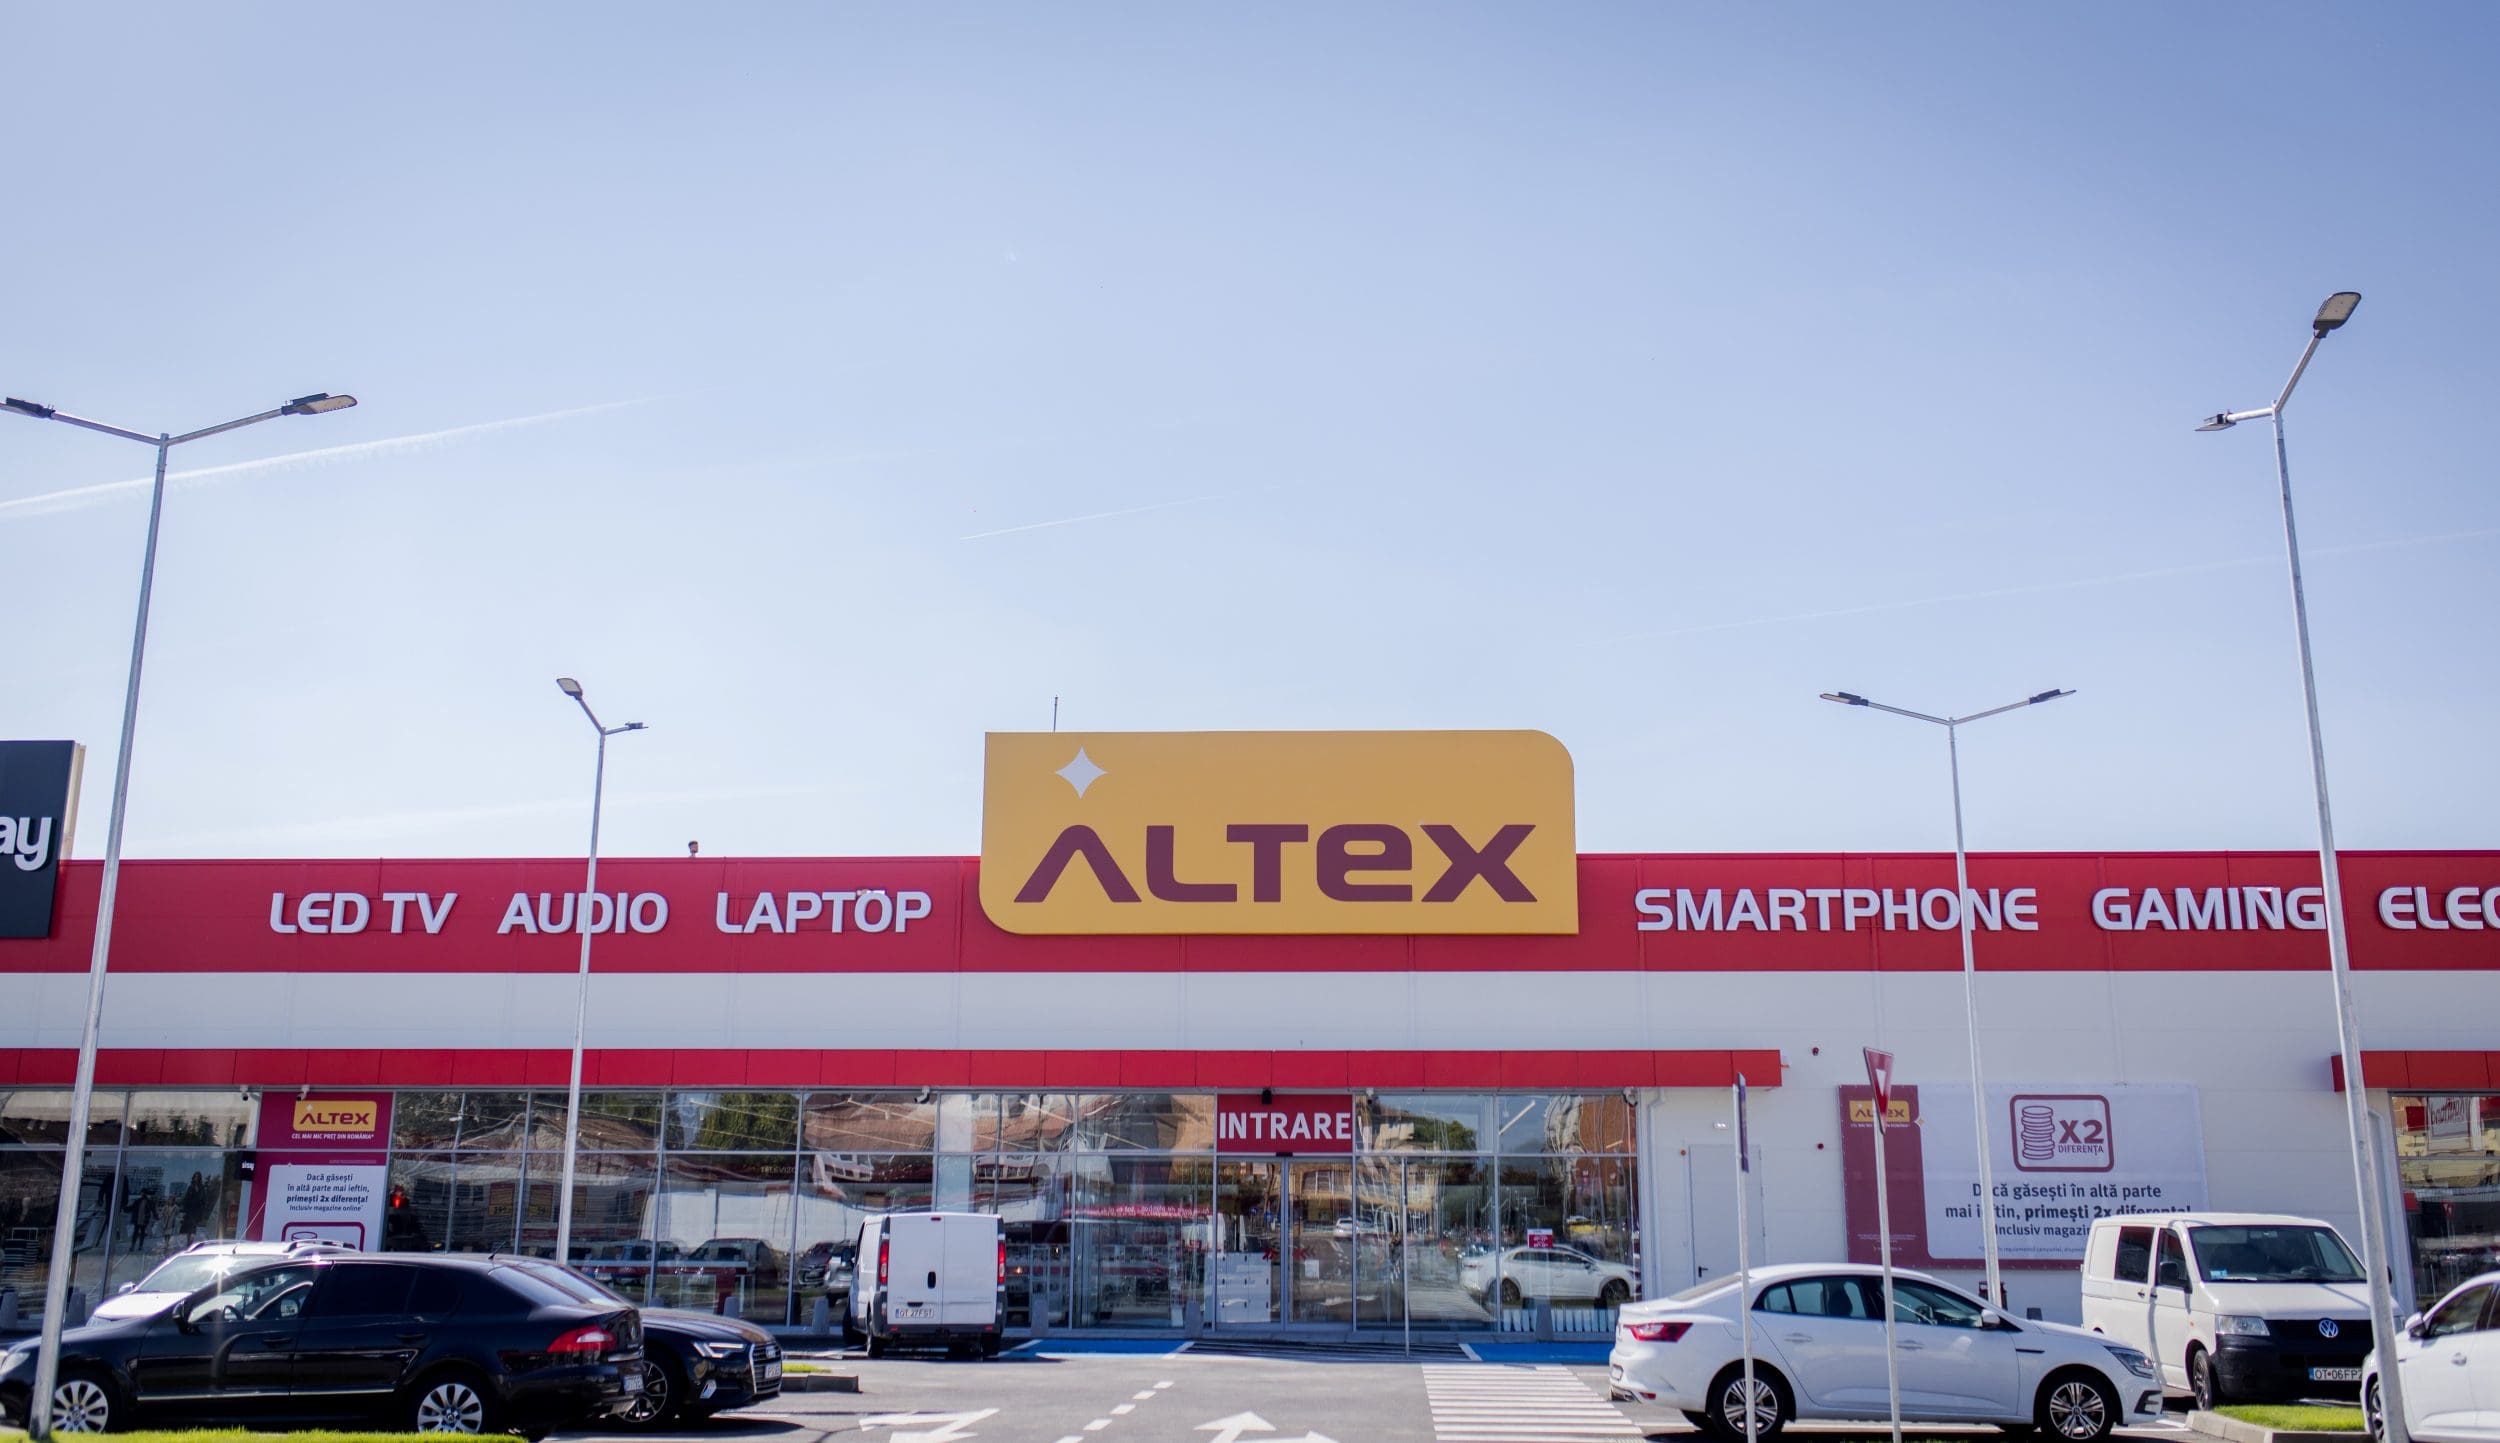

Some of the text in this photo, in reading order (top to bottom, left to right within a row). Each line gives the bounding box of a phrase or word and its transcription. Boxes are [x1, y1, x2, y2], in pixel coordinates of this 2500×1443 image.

[270, 890, 932, 934] LED TV AUDIO LAPTOP
[1634, 888, 2039, 932] SMARTPHONE
[2092, 887, 2328, 931] GAMING
[1219, 1112, 1351, 1139] INTRARE
[2058, 1119, 2104, 1144] X2
[2058, 1145, 2104, 1155] DIFERENȚA
[306, 1173, 325, 1181] Dacă
[287, 1184, 370, 1193] în altă parte mai ieftin,
[1972, 1183, 2162, 1201] Dcă găsești în altă parte
[286, 1195, 369, 1204] primești 2x diferența!
[1945, 1204, 1972, 1218] mai
[2024, 1204, 2089, 1222] primești
[2093, 1205, 2112, 1218] 2x
